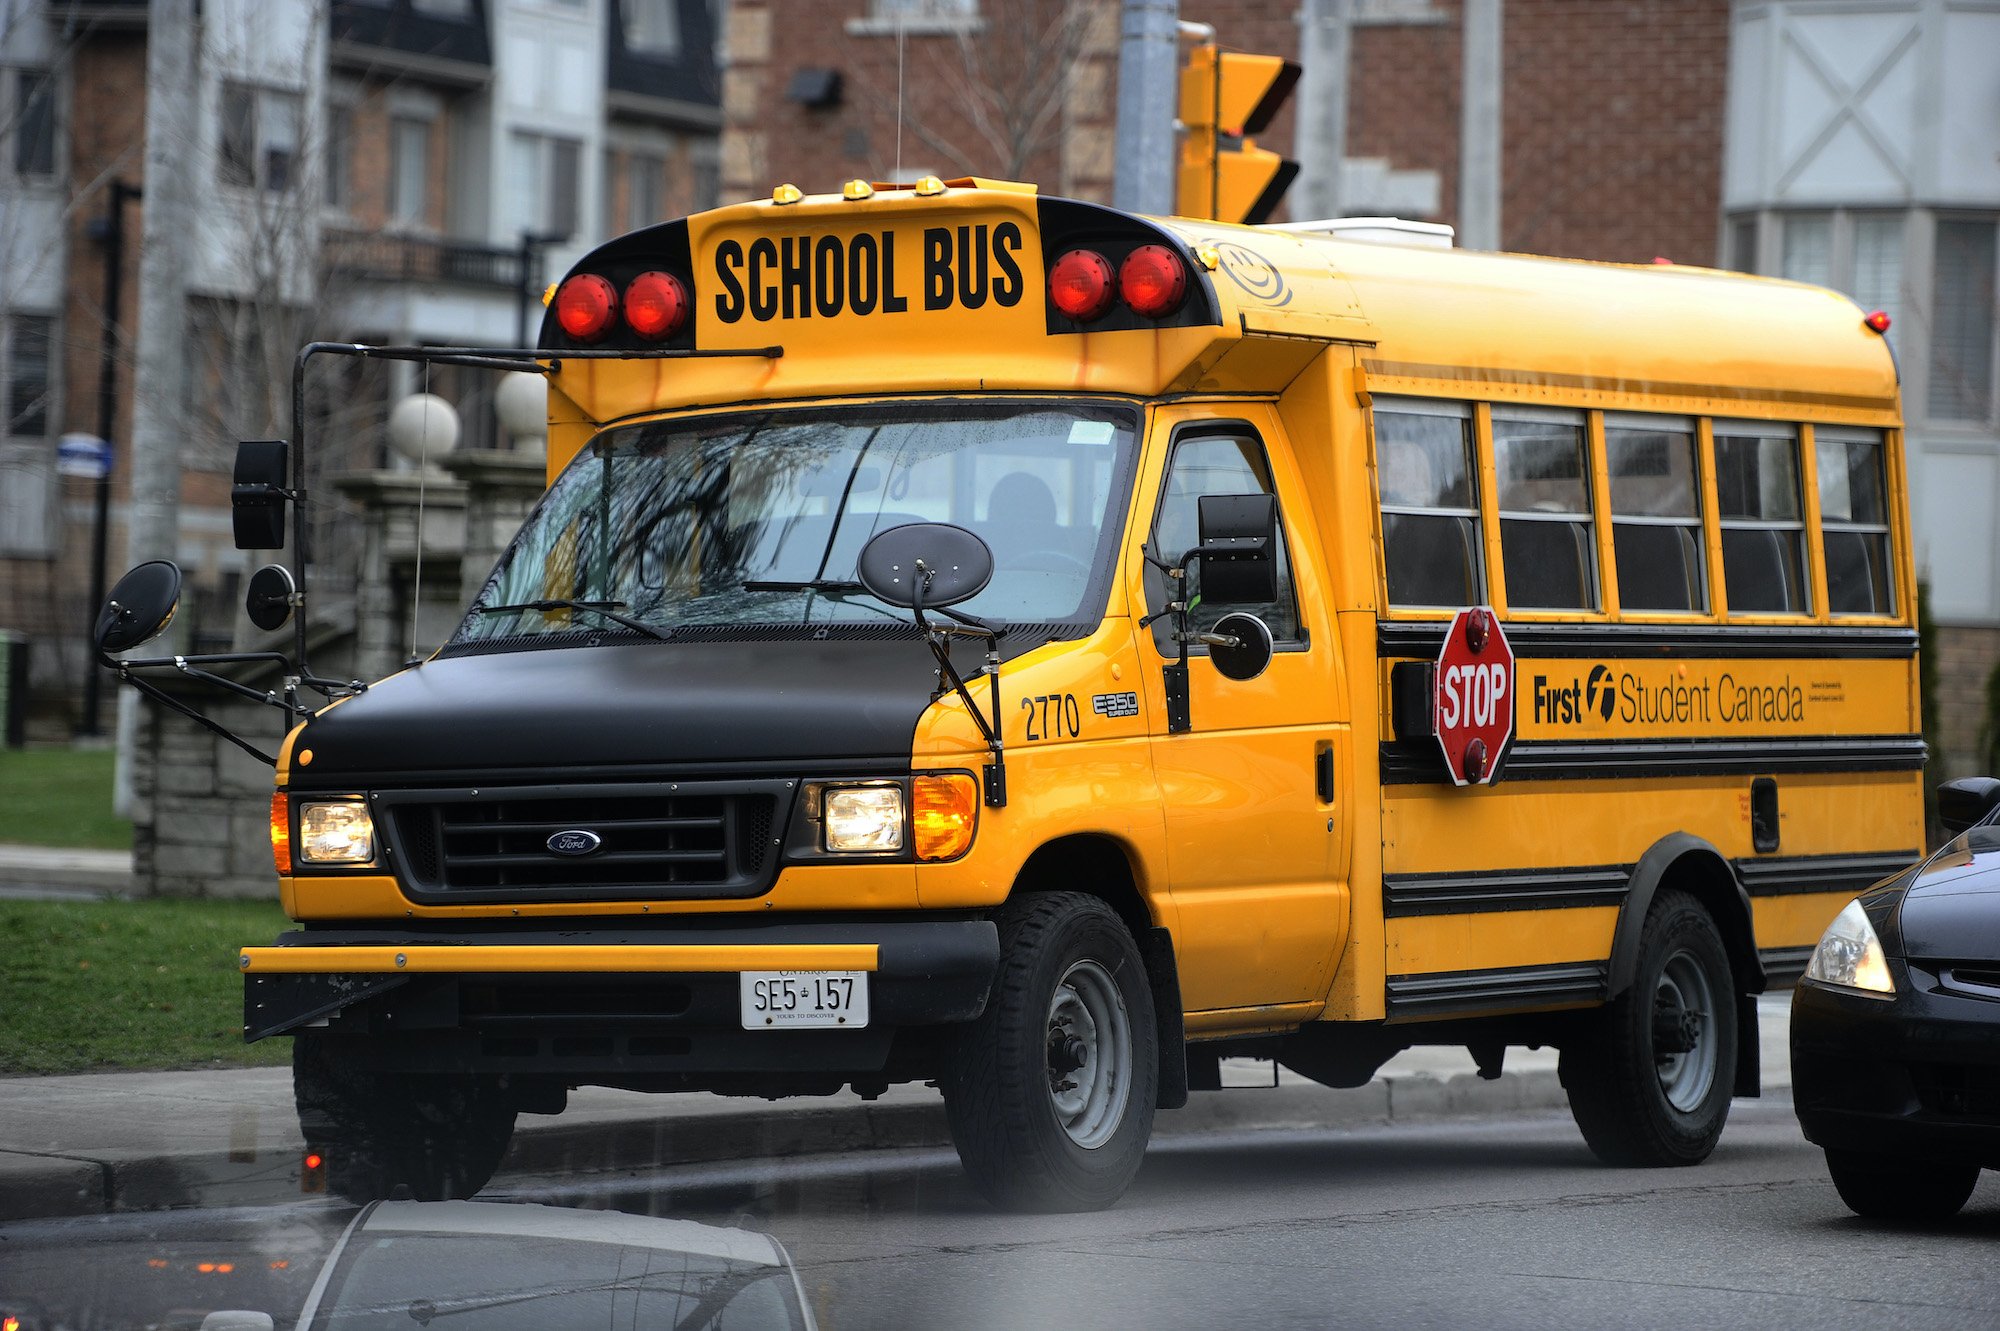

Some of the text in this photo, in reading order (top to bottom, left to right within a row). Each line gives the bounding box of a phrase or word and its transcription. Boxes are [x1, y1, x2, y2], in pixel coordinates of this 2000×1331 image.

[715, 221, 1023, 323] SCHOOL BUS
[1021, 693, 1080, 741] 2770
[1443, 663, 1506, 730] STOP
[1534, 672, 1804, 723] First Student Canada
[559, 835, 587, 849] Ford
[754, 978, 854, 1011] SE5 157
